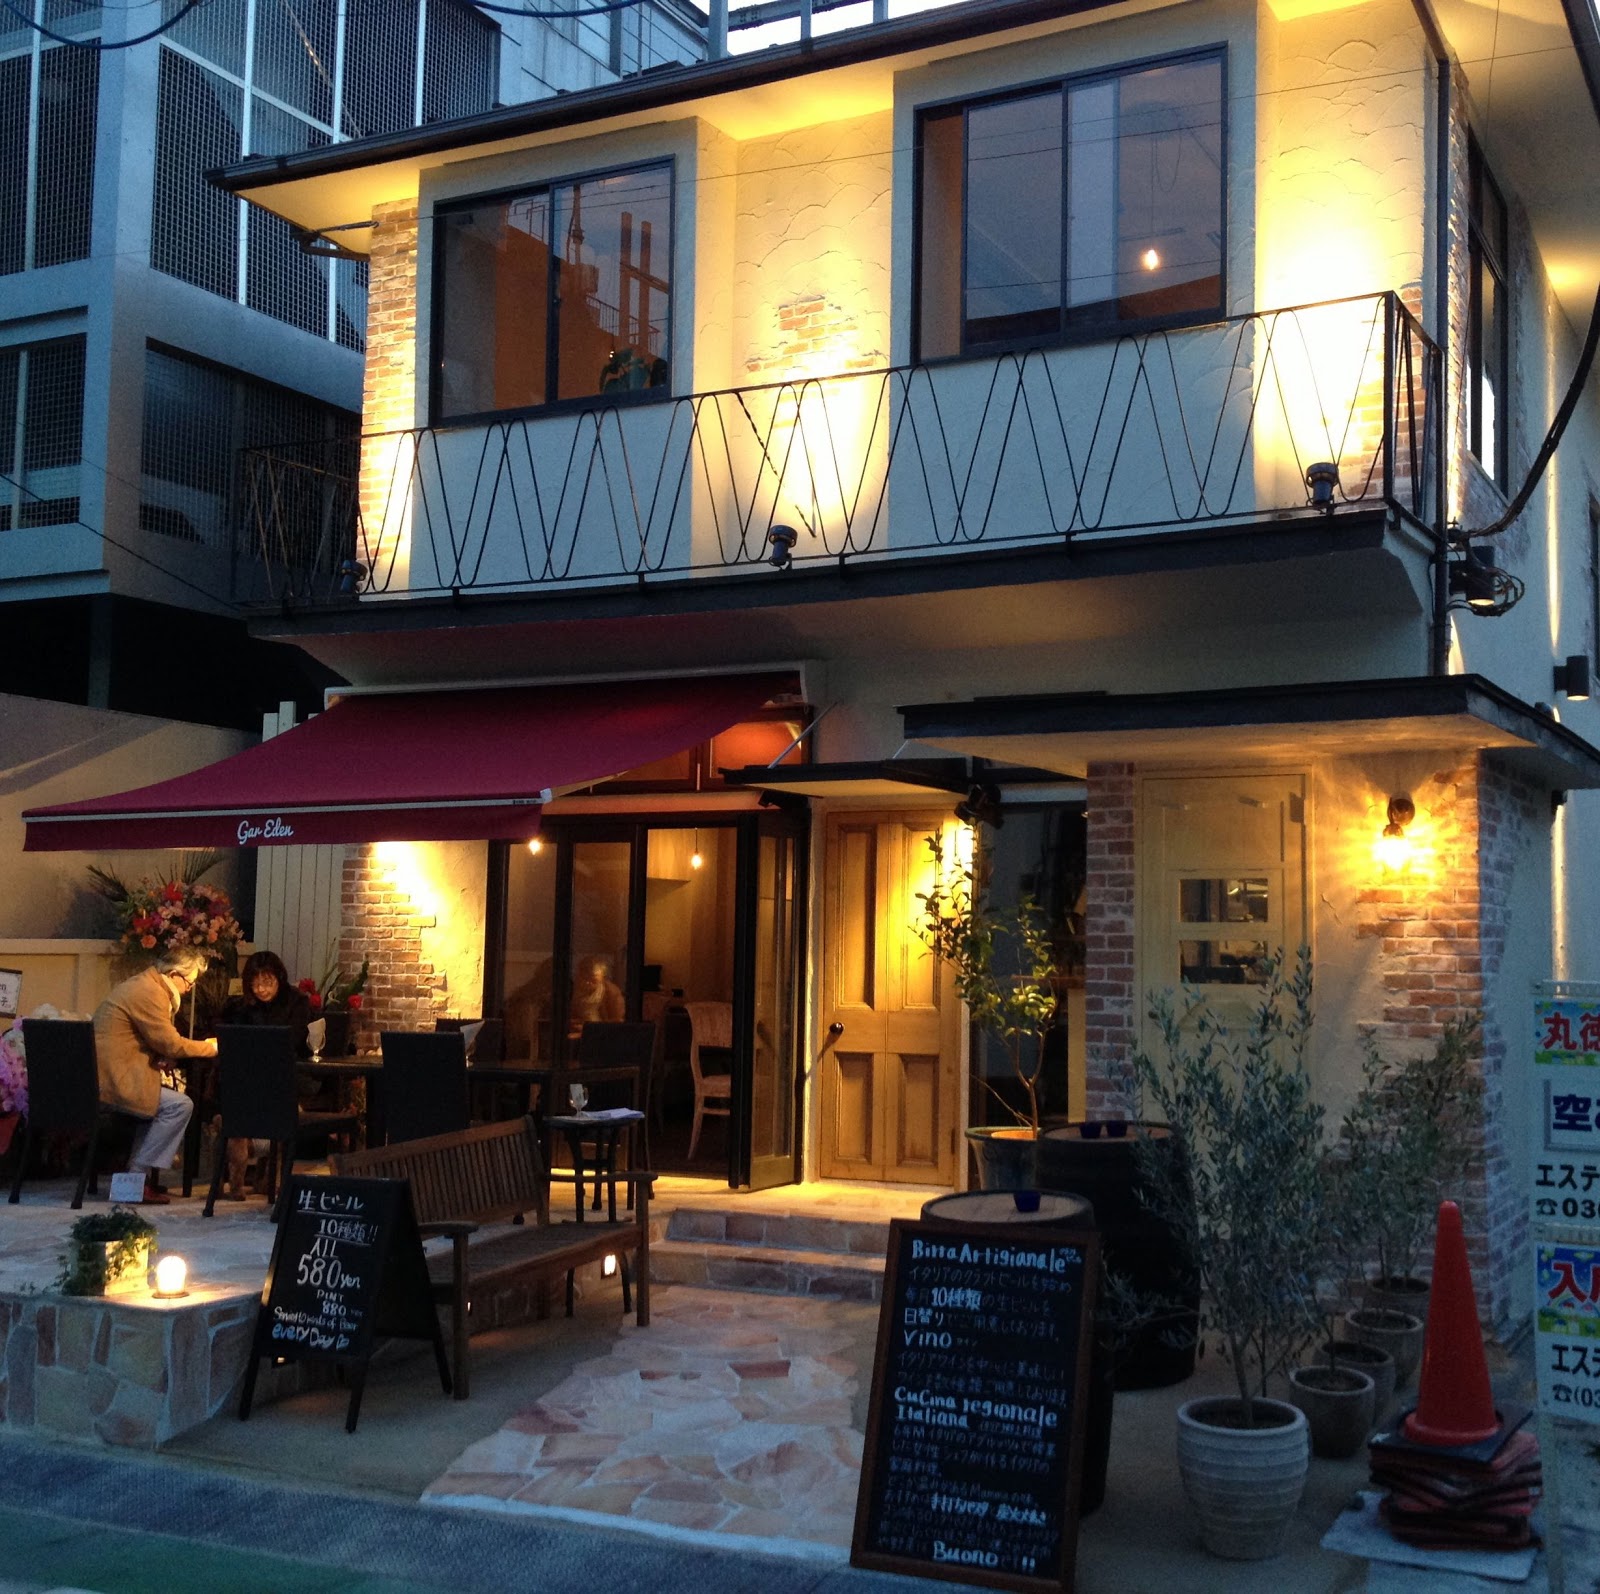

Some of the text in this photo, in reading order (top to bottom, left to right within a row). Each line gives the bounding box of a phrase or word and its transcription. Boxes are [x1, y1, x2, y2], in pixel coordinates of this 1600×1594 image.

[237, 817, 294, 845] Gar Eden
[1553, 1094, 1600, 1131] 空
[1536, 1164, 1600, 1192] エステ
[298, 1189, 365, 1210] 生ビール
[1562, 1198, 1600, 1219] 03
[309, 1237, 339, 1258] ALL
[911, 1239, 1066, 1274] Birra Artigianale
[297, 1253, 361, 1290] 580 yen
[1548, 1261, 1600, 1304] 入
[316, 1289, 344, 1303] PINT
[322, 1301, 347, 1316] 880
[272, 1322, 336, 1348] every Day
[327, 1317, 337, 1330] of
[897, 1405, 970, 1428] Italiana
[933, 1540, 998, 1568] Buono
